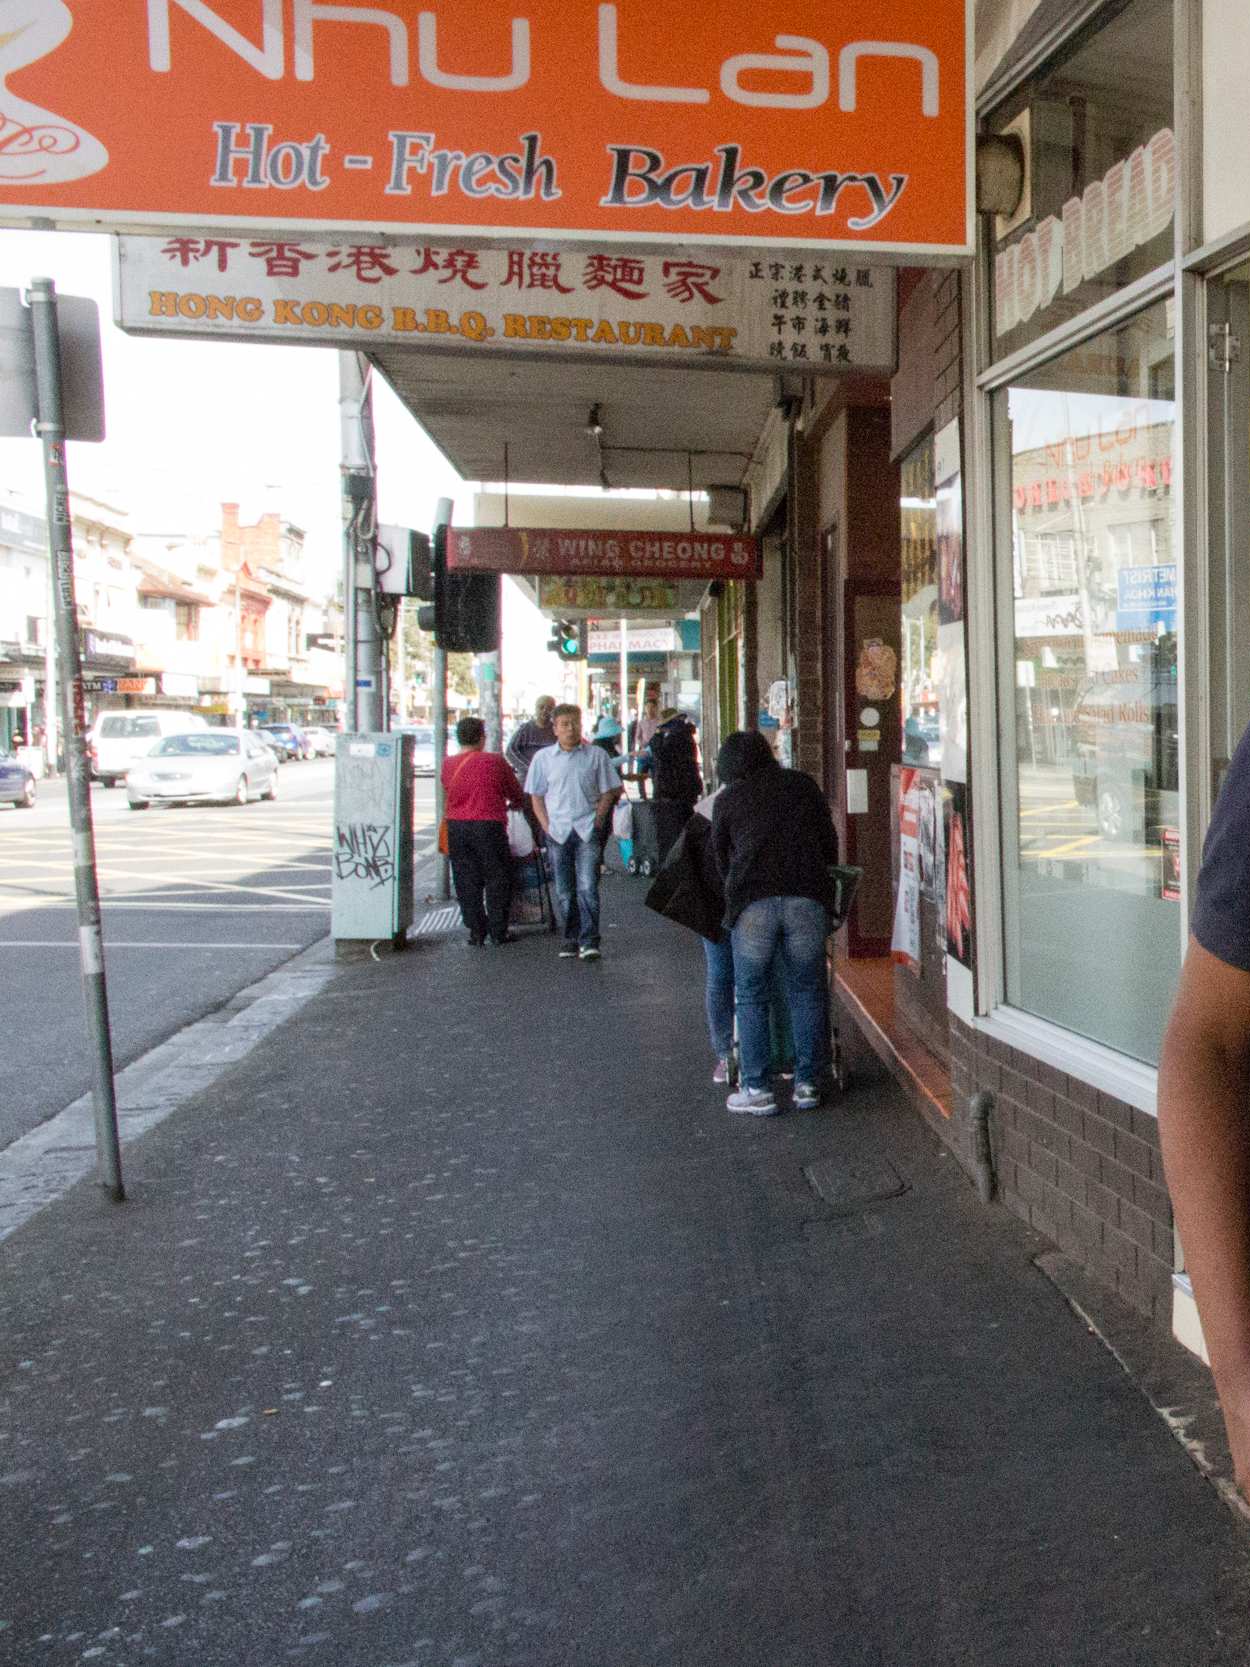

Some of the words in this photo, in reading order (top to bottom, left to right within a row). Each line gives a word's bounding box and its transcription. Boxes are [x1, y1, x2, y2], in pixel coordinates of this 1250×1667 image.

[147, 0, 531, 92] Nhu
[598, 3, 940, 118] Lan
[211, 122, 331, 191] Hot
[385, 131, 562, 201] Fresh
[599, 143, 909, 231] Bakery
[148, 290, 265, 322] HONG
[271, 300, 384, 330] KONG
[391, 305, 496, 342] B.B.Q.
[503, 314, 738, 351] RESTAURANT
[558, 539, 622, 557] WING
[629, 541, 726, 560] CHEONG
